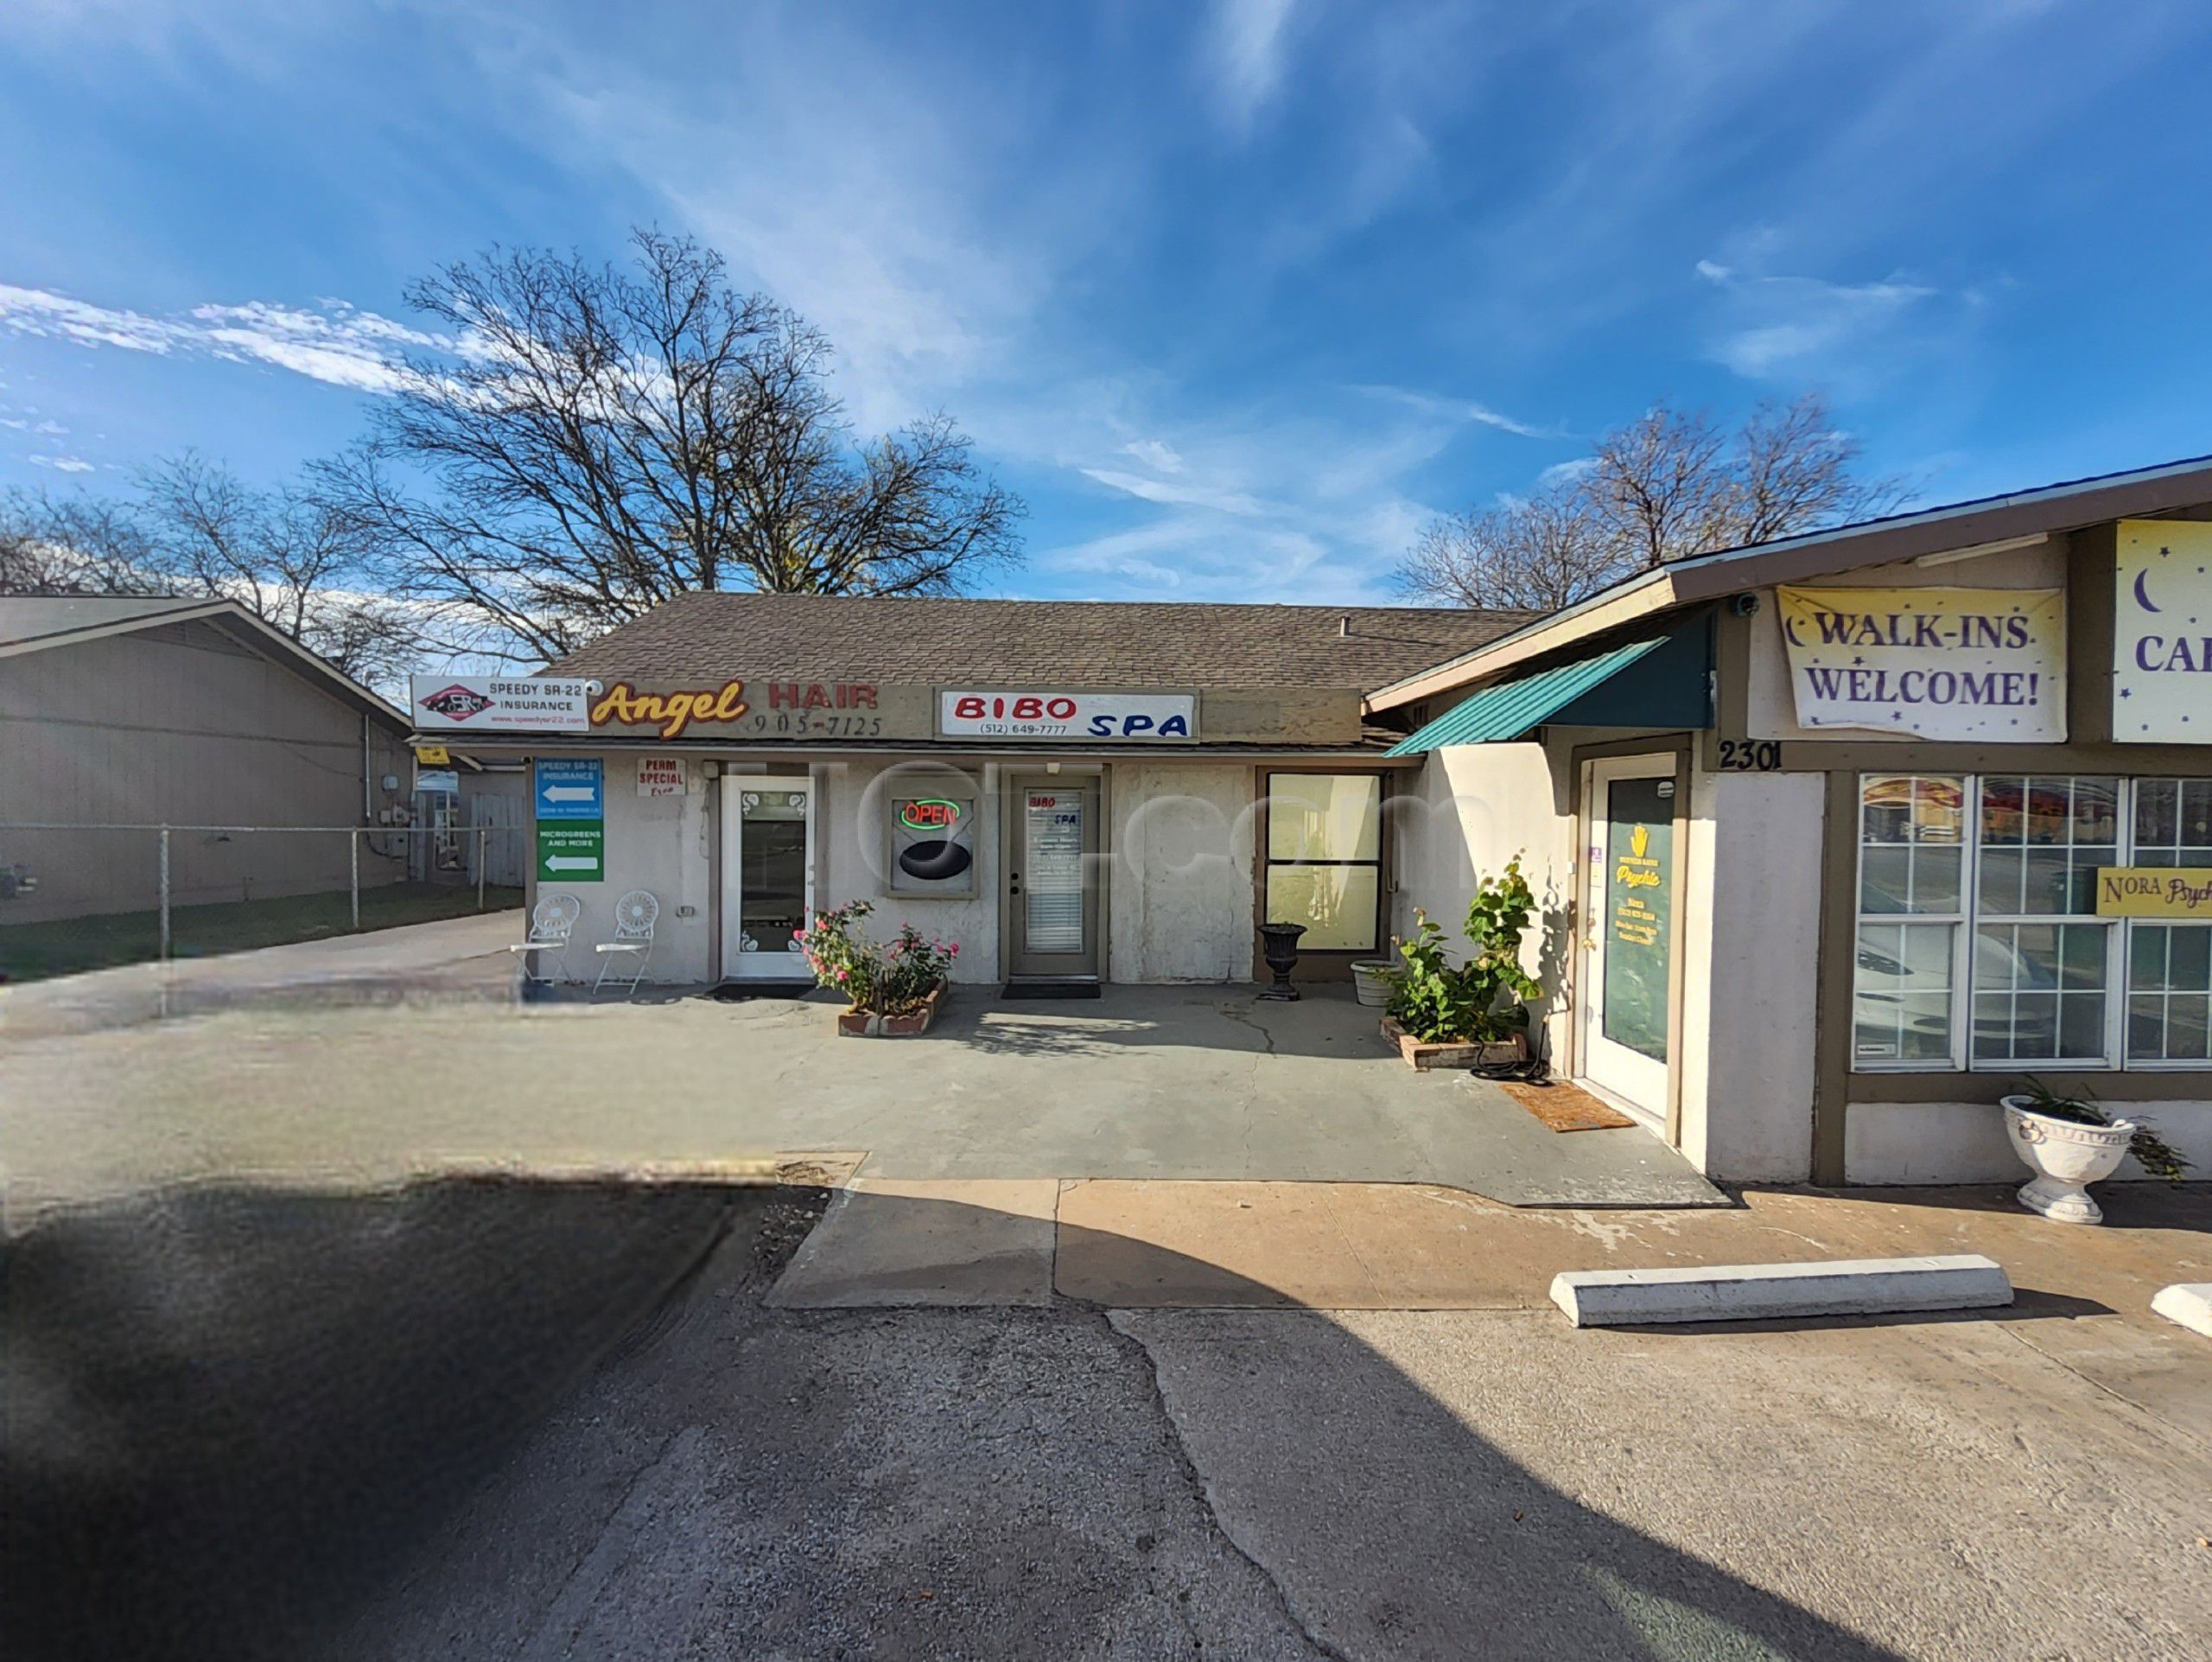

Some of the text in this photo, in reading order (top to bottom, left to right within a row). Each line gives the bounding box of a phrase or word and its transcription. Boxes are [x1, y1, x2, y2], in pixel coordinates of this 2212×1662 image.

[1814, 611, 2031, 650] WALK-INS
[489, 683, 582, 697] SPEEDY SR-22
[769, 683, 879, 710] HAIR
[1803, 666, 2040, 706] WELCOME!
[499, 700, 575, 711] INSURANCE
[590, 679, 749, 742] Angel
[954, 697, 1077, 720] BIBO
[979, 723, 1067, 735] (512) 649-7777
[1086, 714, 1189, 737] SPA
[1719, 741, 1783, 771] 2301
[543, 772, 594, 780] INSURANCE
[639, 773, 683, 785] SPECIAL
[1029, 798, 1056, 807] BIBO
[904, 804, 957, 825] OPEN
[1055, 815, 1077, 825] SPA
[2103, 876, 2162, 903] NORA
